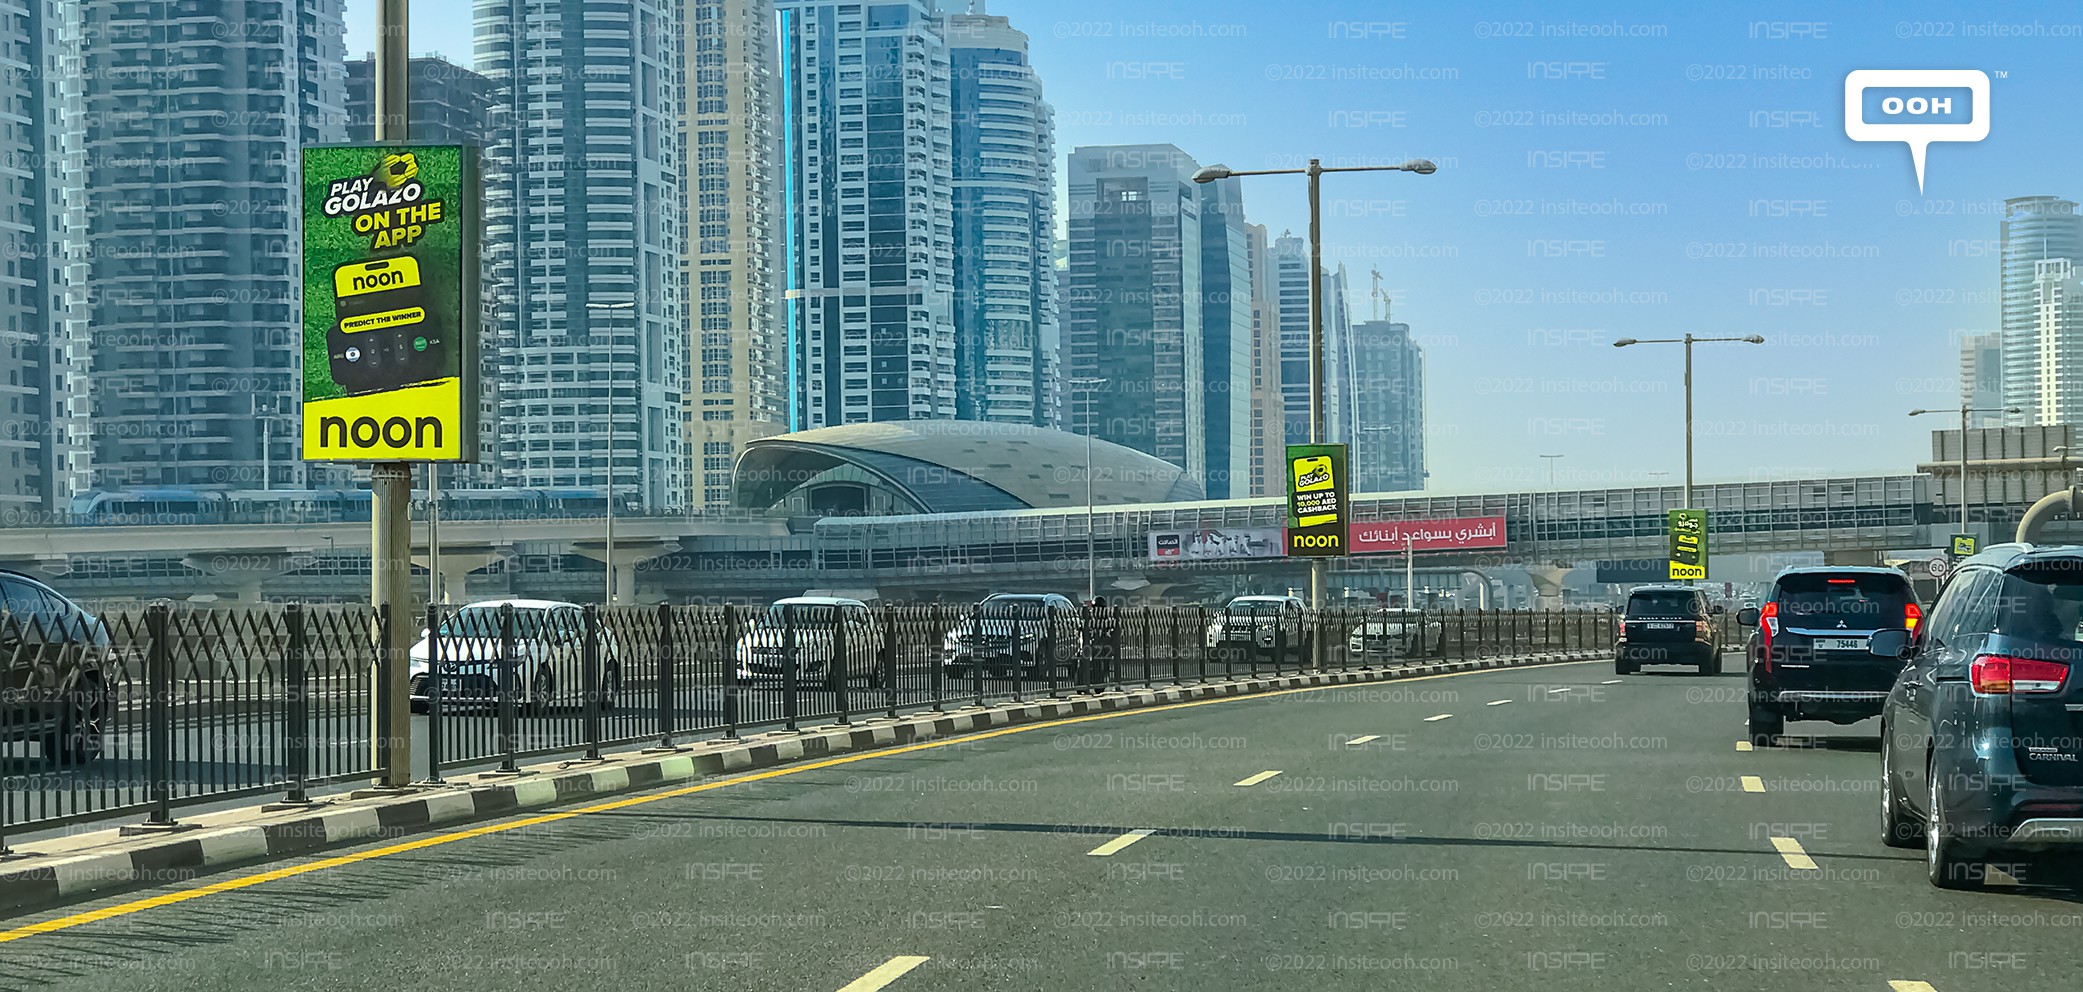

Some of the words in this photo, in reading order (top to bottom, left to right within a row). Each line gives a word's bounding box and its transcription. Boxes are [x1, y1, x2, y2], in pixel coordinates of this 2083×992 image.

[331, 177, 374, 197] PLAY
[324, 183, 422, 215] GOLAZO
[355, 211, 390, 233] ON
[396, 202, 441, 226] THE
[374, 225, 422, 249] APP
[352, 270, 404, 291] noon
[343, 317, 375, 329] PREDICT
[376, 316, 391, 324] THE
[392, 311, 422, 321] WINNER
[320, 414, 443, 449] noon
[1299, 474, 1329, 486] GOLAZO
[1297, 504, 1337, 514] CASHBACK
[1293, 535, 1339, 548] noon
[1358, 526, 1399, 545] أبنائك
[1455, 521, 1496, 544] أبشري
[1672, 568, 1702, 577] noon
[1931, 563, 1944, 572] 60
[2029, 753, 2078, 762] CARNIVAL
